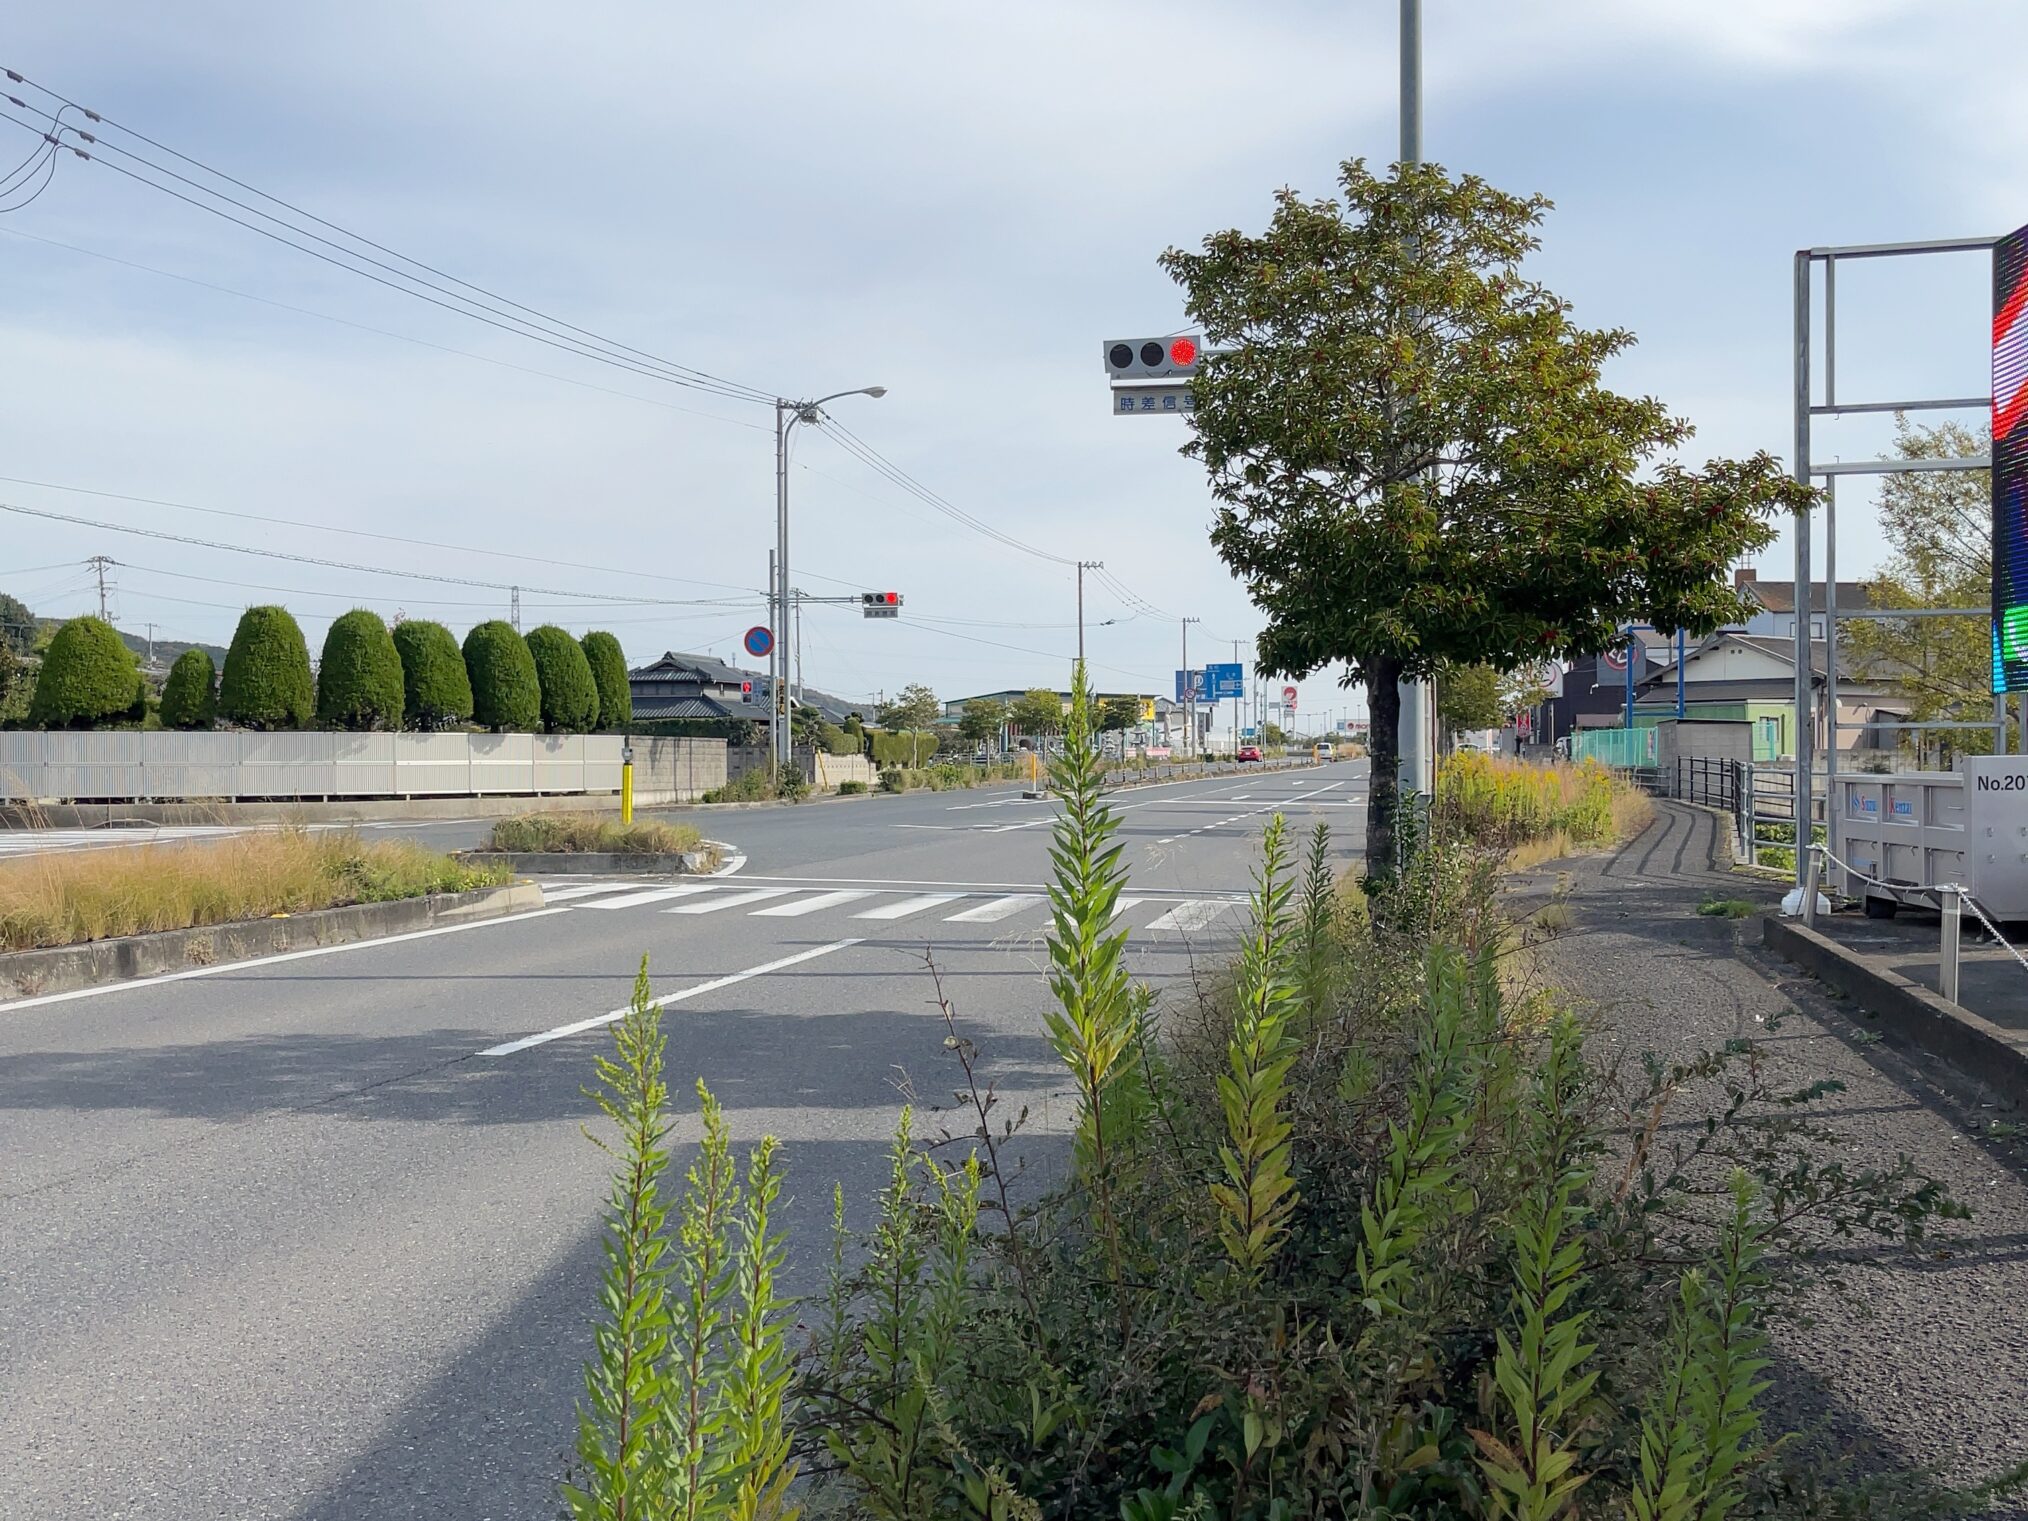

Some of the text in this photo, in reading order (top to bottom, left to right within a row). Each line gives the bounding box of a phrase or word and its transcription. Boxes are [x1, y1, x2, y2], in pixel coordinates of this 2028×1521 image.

[1120, 395, 1195, 411] 時差信号
[1978, 775, 2028, 791] No.20
